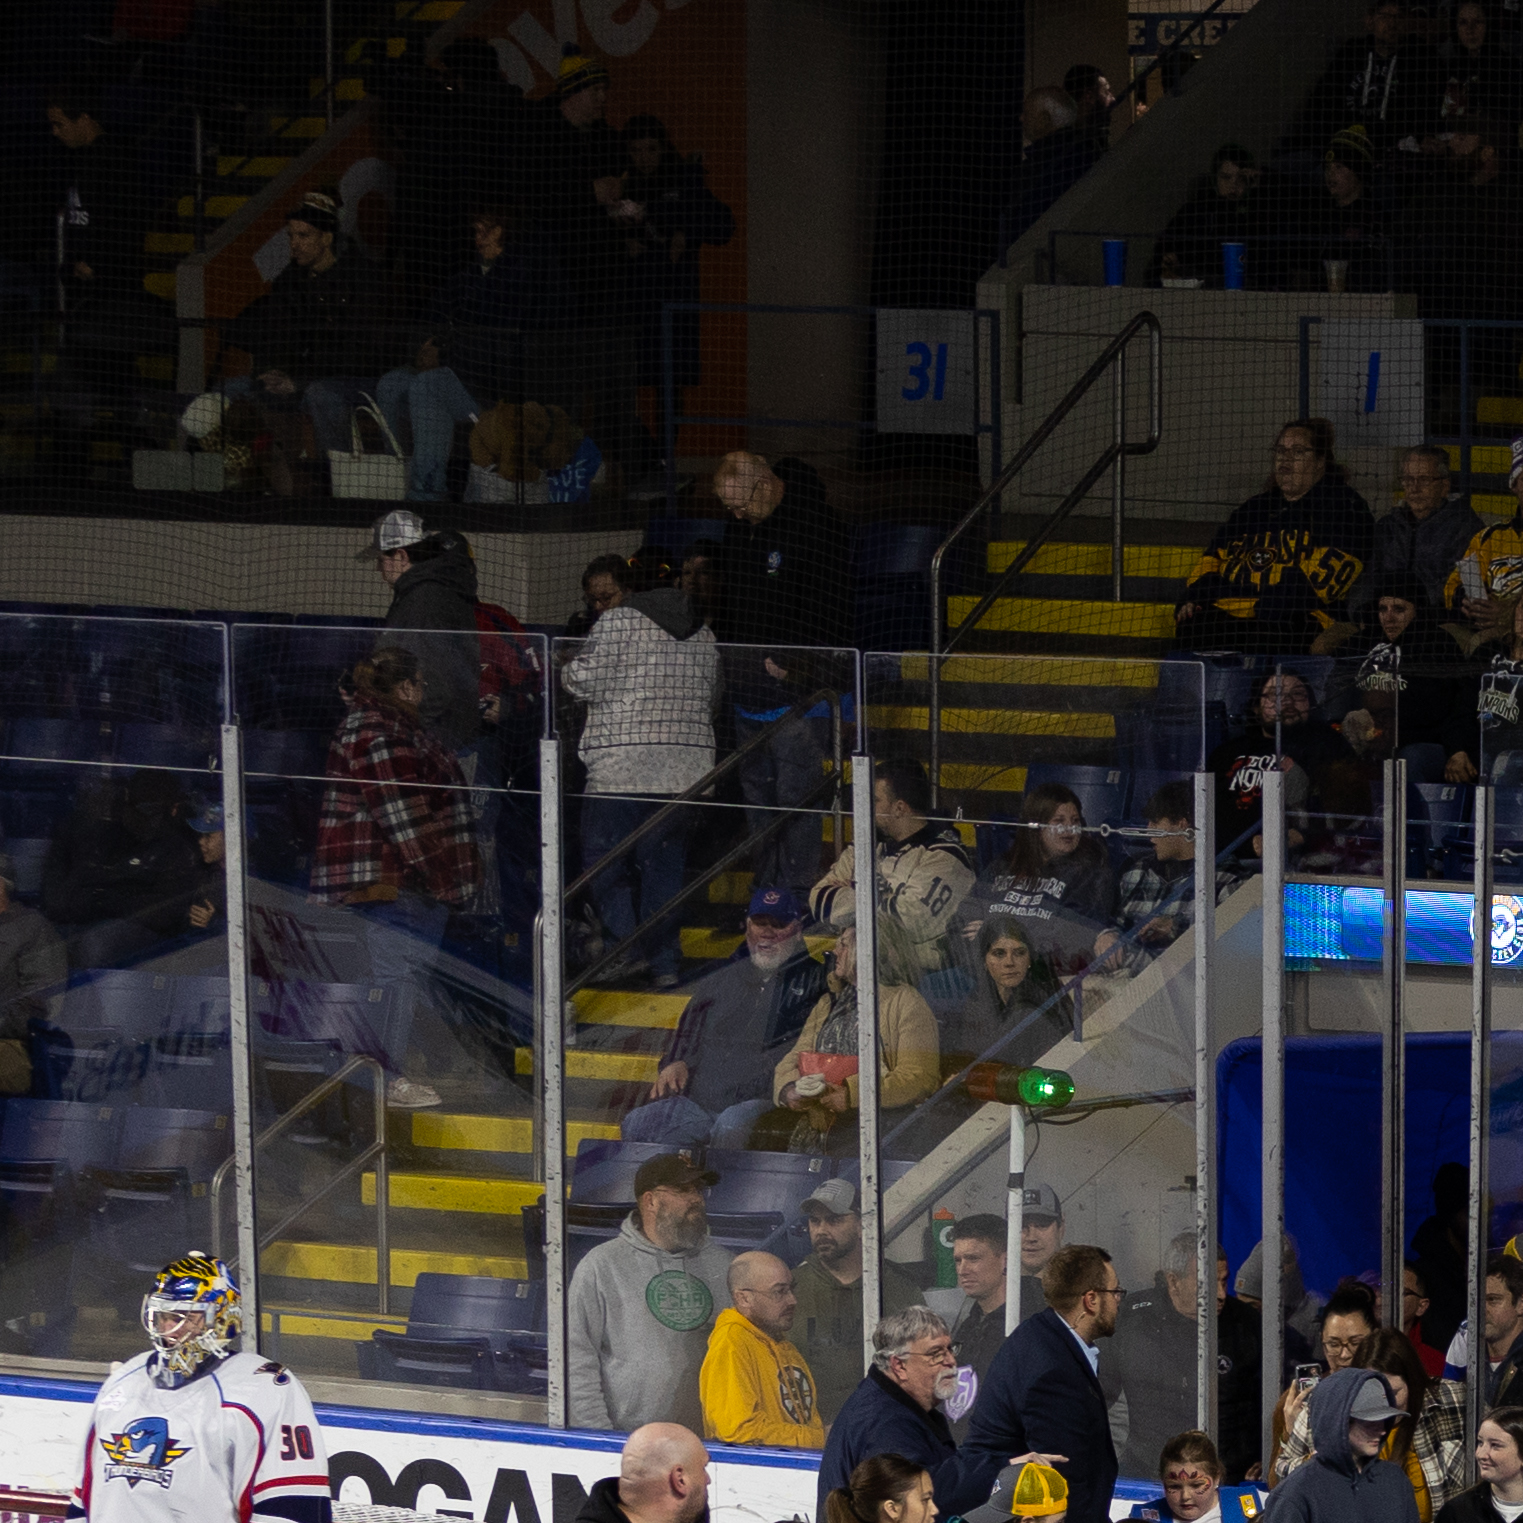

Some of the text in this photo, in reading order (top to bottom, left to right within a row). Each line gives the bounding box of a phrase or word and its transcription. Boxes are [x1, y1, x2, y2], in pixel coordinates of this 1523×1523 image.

[901, 341, 949, 402] 31
[1364, 352, 1381, 413] 1
[920, 876, 952, 917] 18
[280, 1424, 315, 1461] 30
